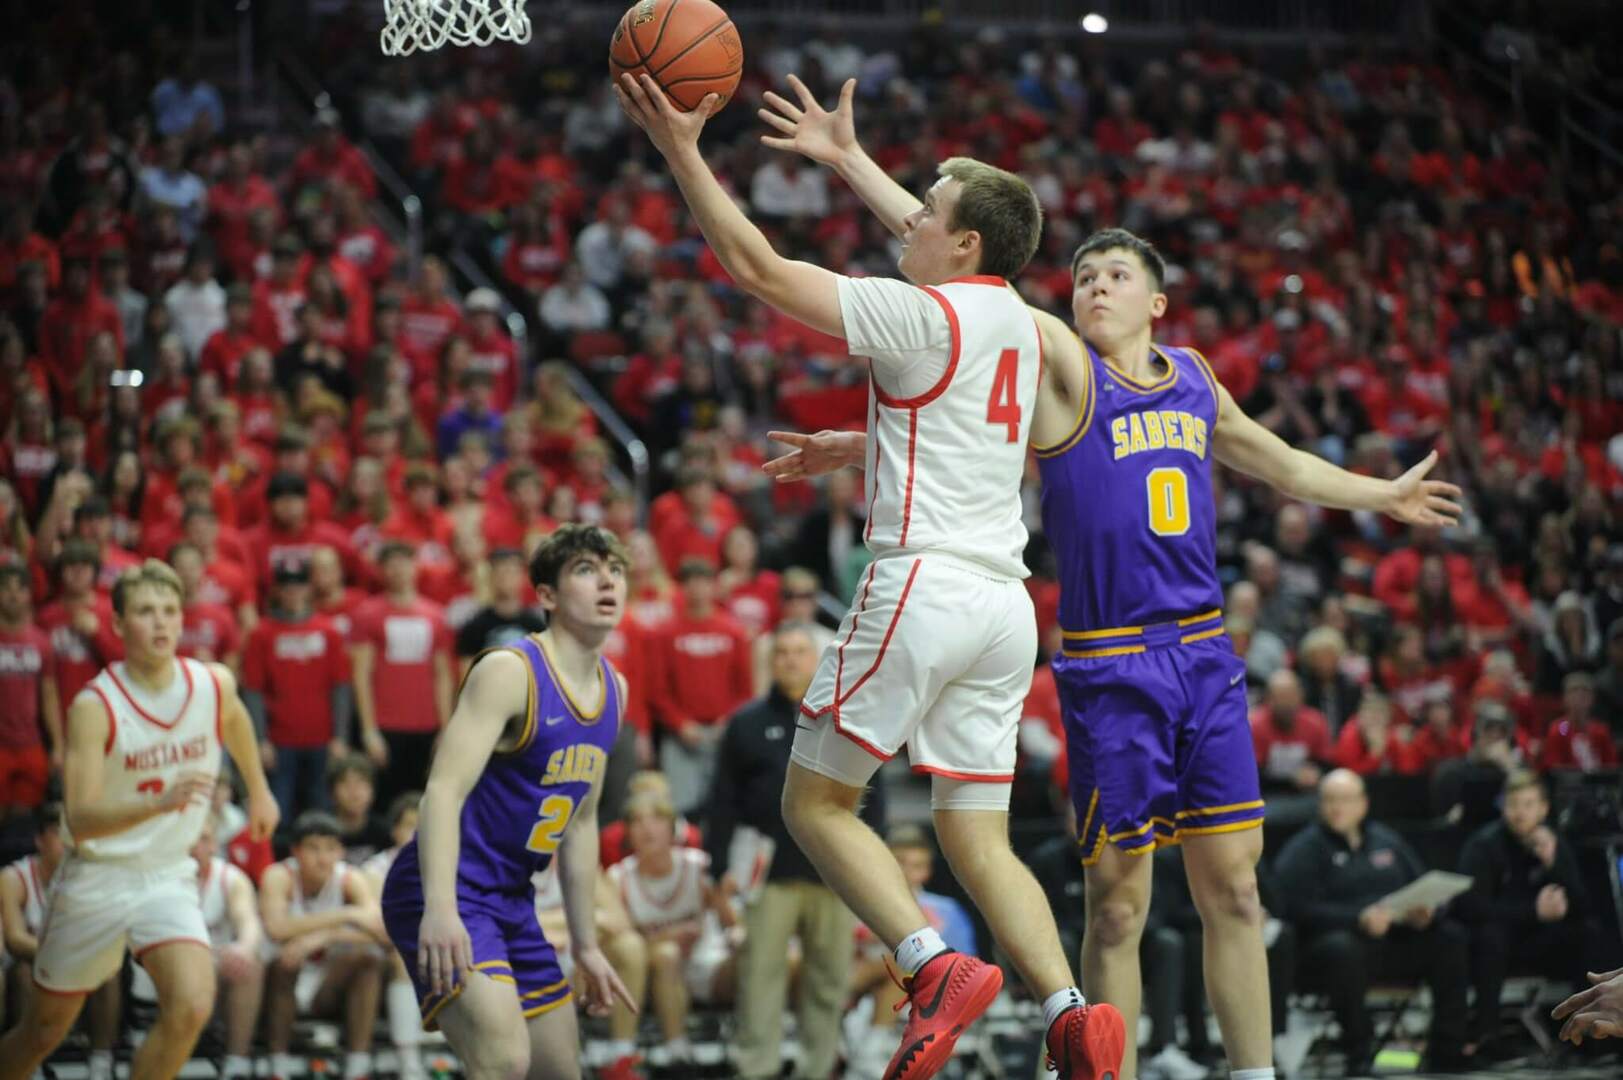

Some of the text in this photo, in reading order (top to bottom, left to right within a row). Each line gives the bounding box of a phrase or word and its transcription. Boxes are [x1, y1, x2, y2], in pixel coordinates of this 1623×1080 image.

[986, 348, 1021, 444] 4
[1111, 410, 1207, 460] SABERS
[1146, 467, 1190, 536] 0
[525, 794, 574, 854] 2
